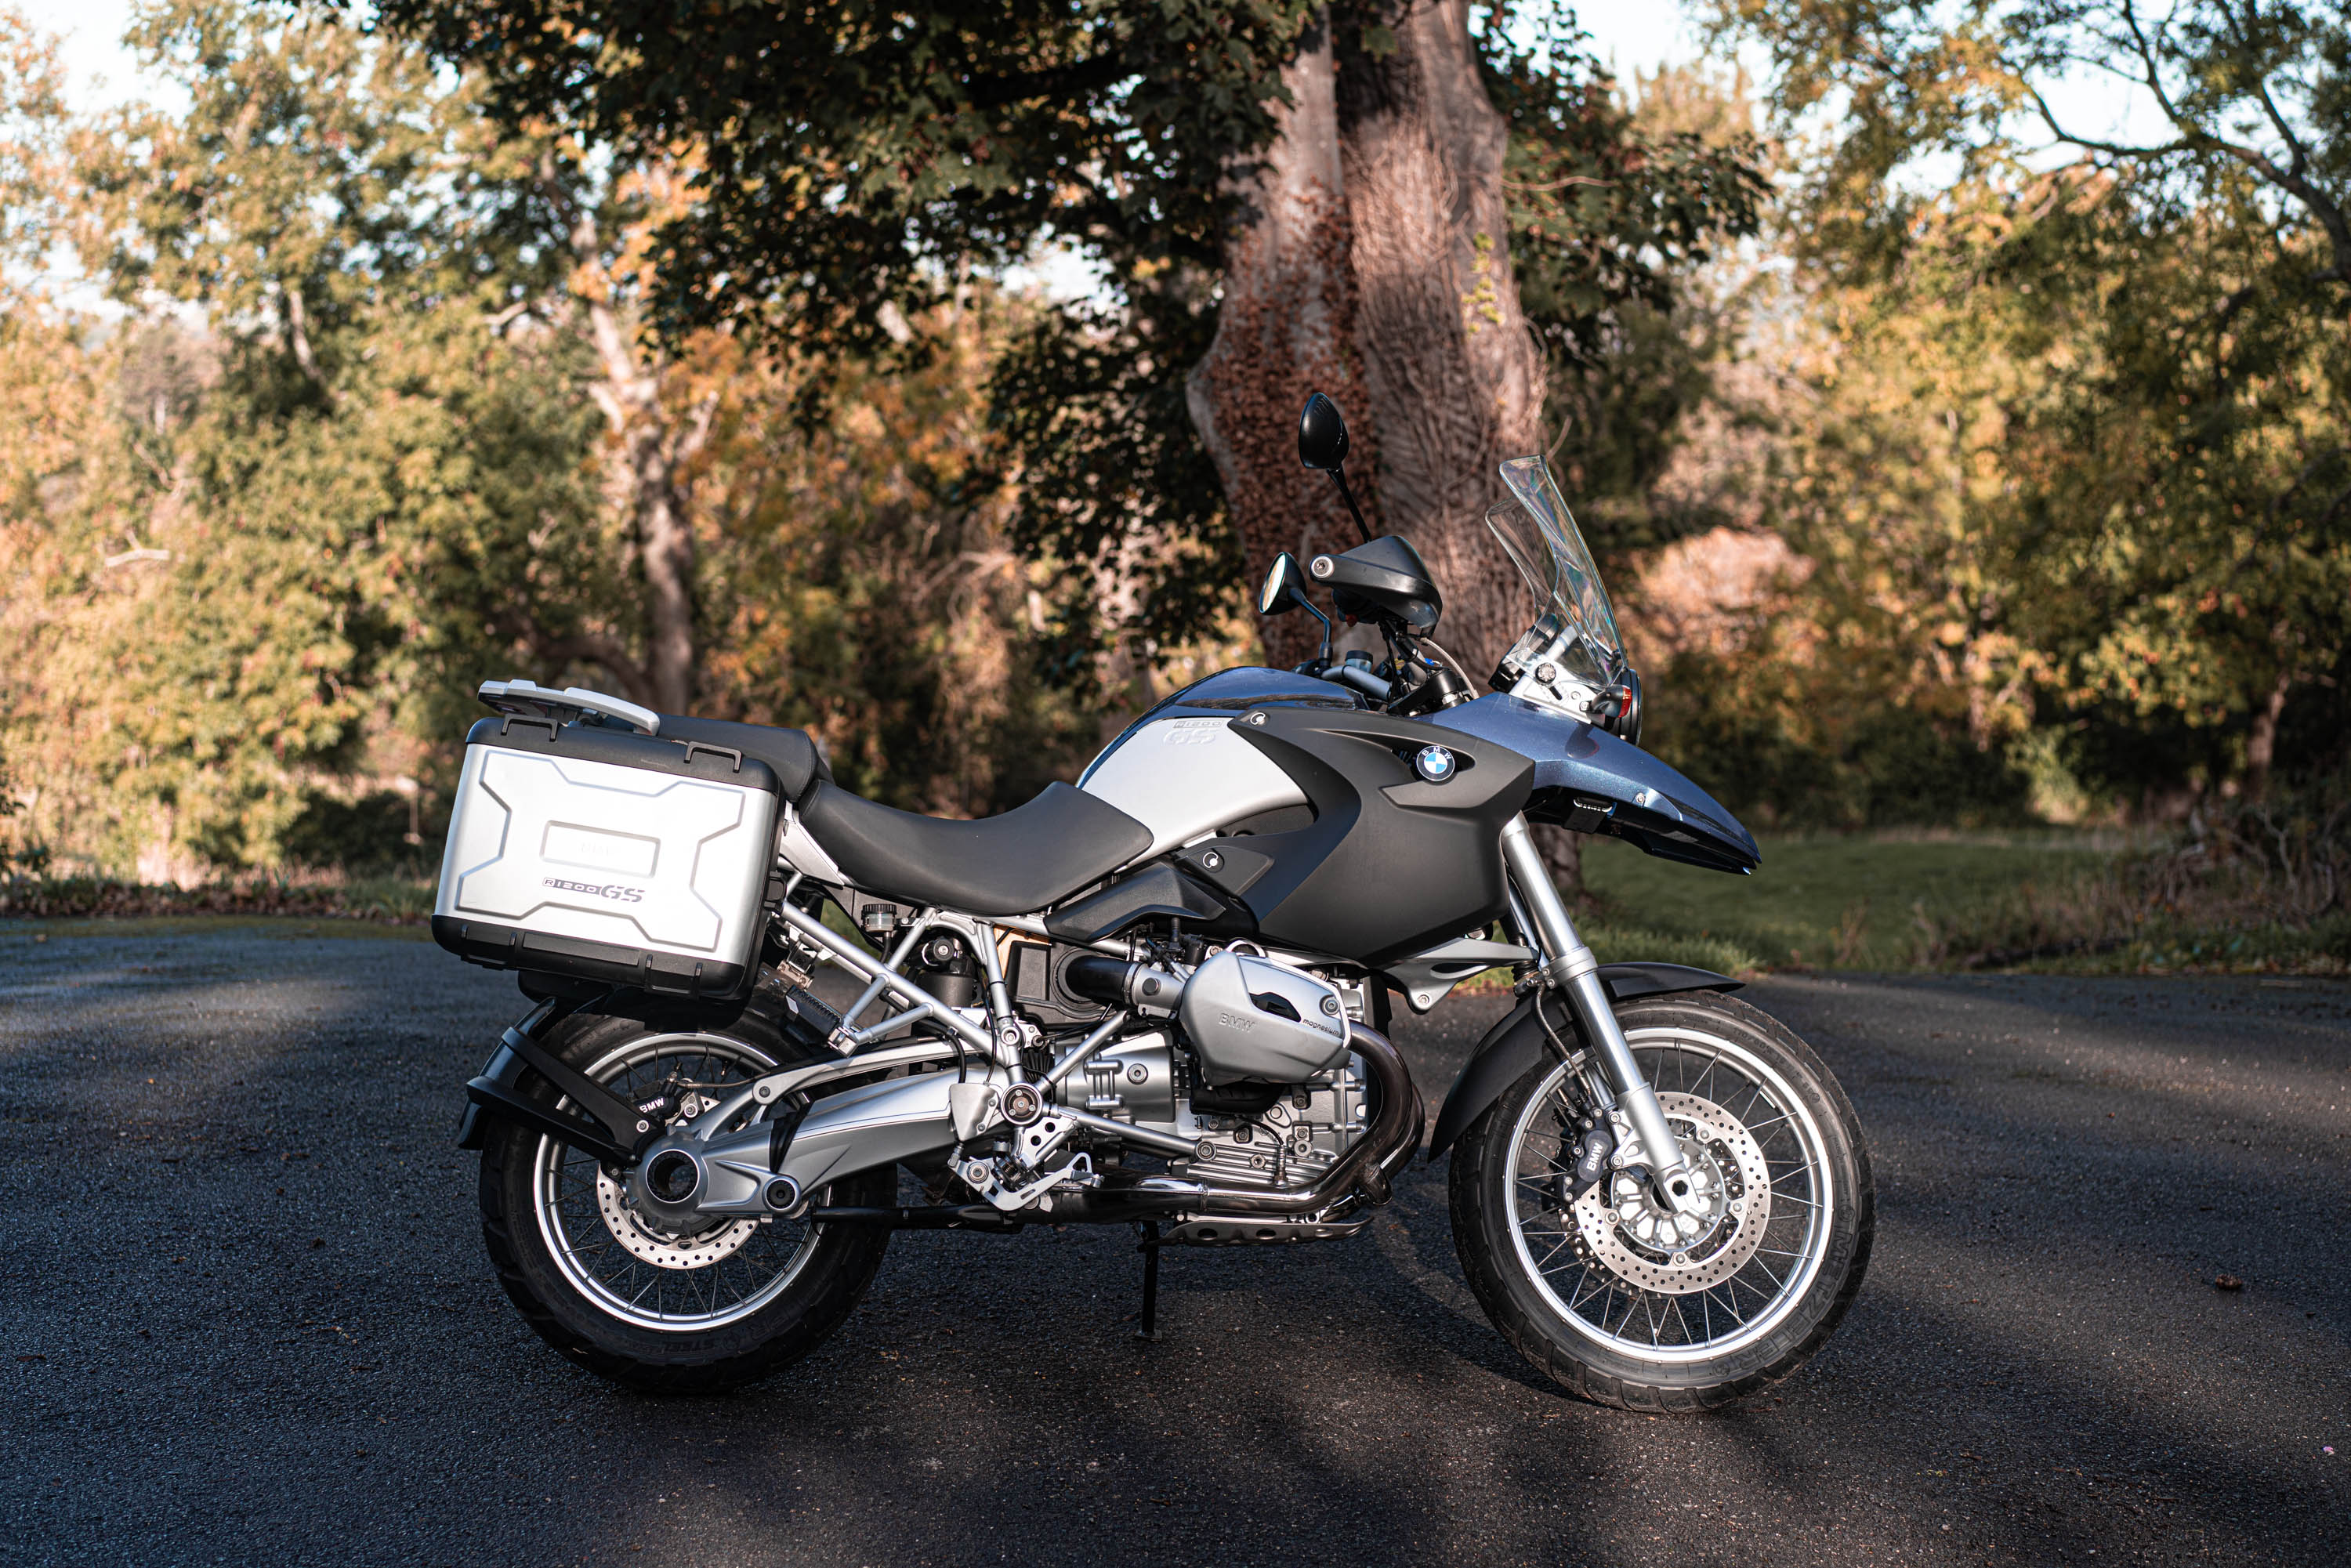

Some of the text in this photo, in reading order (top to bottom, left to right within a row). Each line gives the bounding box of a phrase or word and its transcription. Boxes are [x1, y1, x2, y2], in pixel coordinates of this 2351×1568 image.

[1163, 729, 1220, 745] GS
[1422, 747, 1452, 759] BMW
[1218, 1012, 1255, 1034] BMW
[1302, 1018, 1340, 1036] magnesium
[639, 1097, 665, 1113] BMW
[1586, 1142, 1603, 1171] BMW
[1734, 1231, 1853, 1371] METZELER
